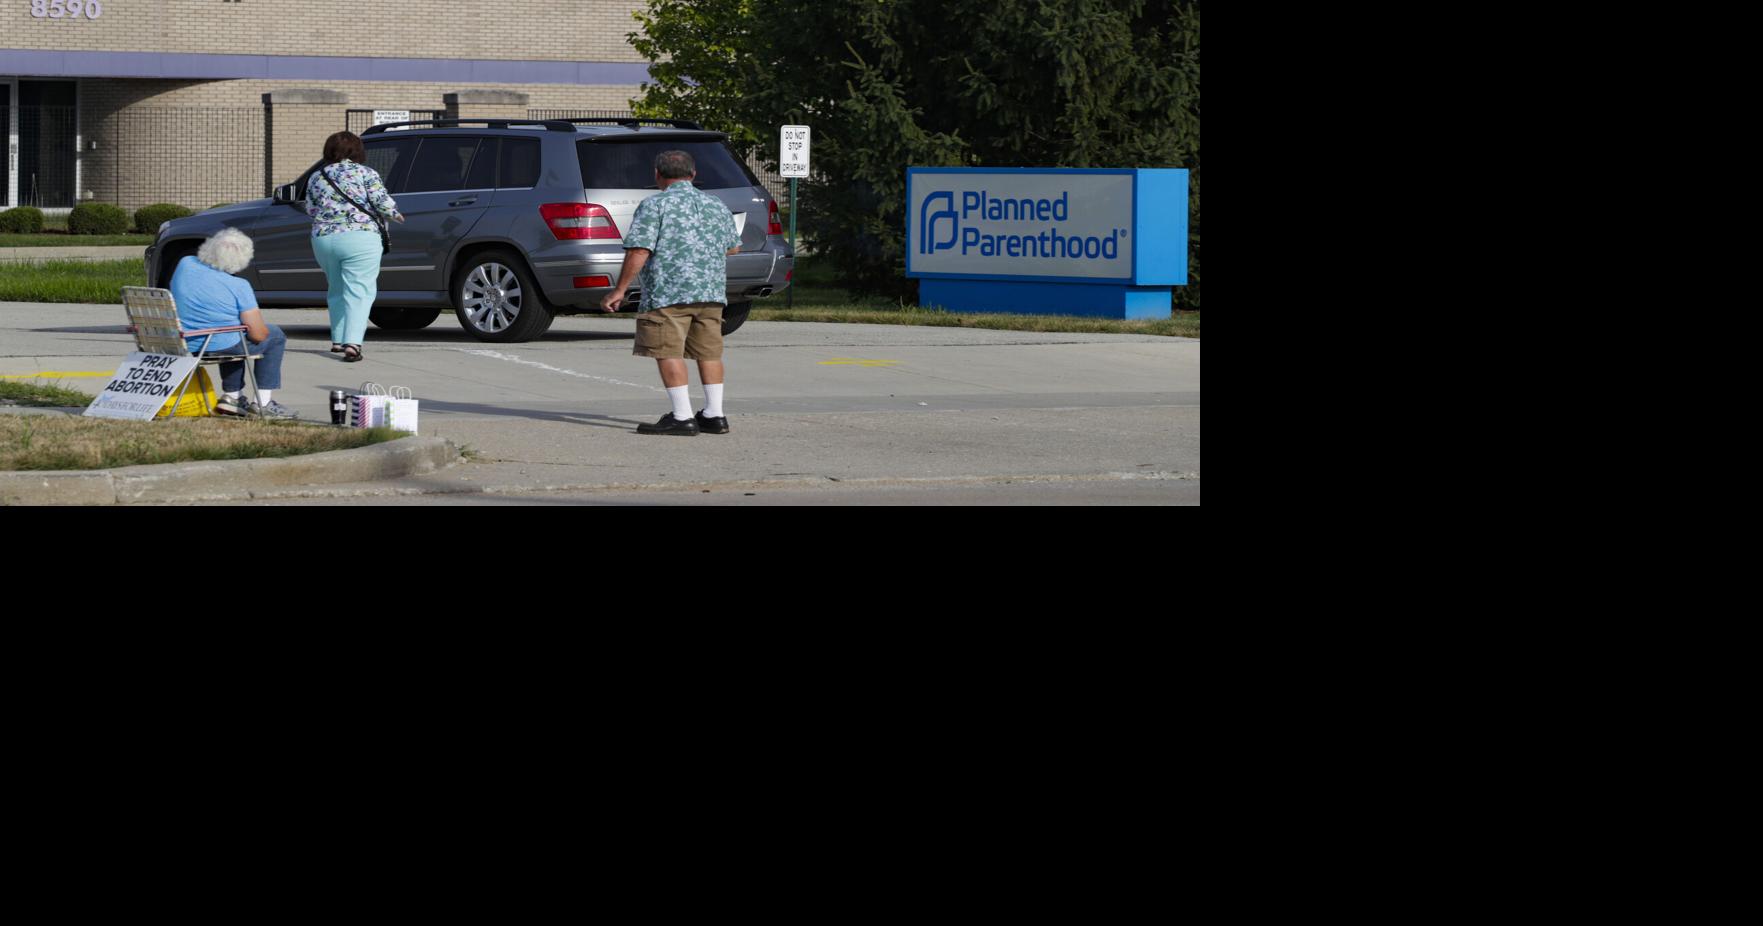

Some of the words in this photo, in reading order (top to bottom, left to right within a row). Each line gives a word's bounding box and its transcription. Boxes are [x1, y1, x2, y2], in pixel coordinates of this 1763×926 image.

[30, 0, 102, 19] 8590
[785, 131, 794, 140] DO
[794, 131, 806, 140] NOT
[788, 141, 803, 151] STOP
[782, 163, 807, 172] DRIVEWAY
[962, 190, 1068, 221] Planned
[140, 355, 177, 369] PRAY
[125, 368, 145, 379] TO
[144, 370, 172, 382] END
[104, 380, 174, 397] ABORTION
